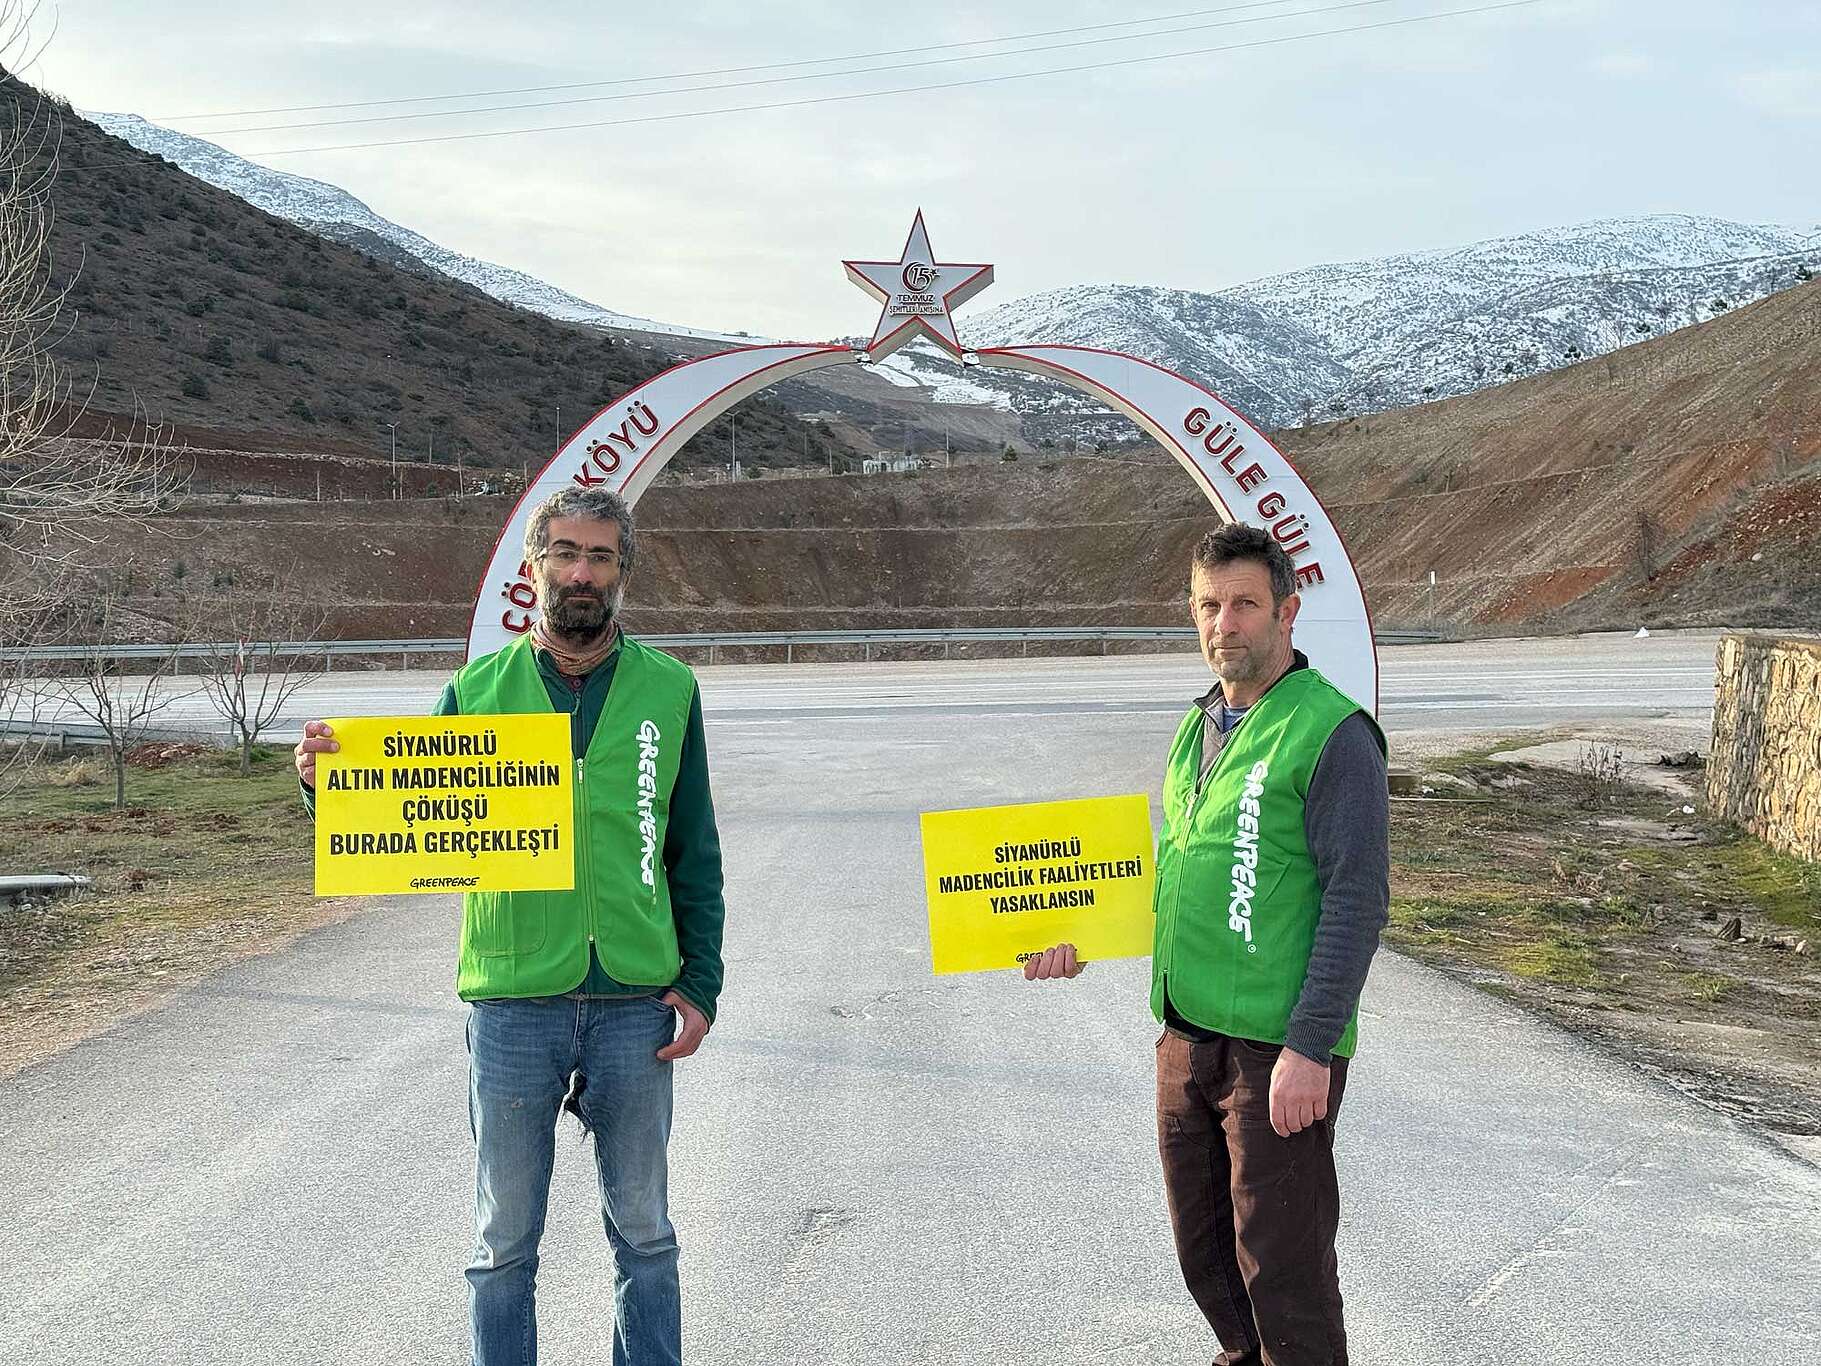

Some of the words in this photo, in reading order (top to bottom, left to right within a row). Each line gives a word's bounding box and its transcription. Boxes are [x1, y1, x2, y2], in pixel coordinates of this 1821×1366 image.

[912, 267, 931, 287] 15
[897, 294, 934, 302] TEMMUZ
[573, 400, 660, 488] KÖYÜ
[1183, 407, 1268, 494] GÜLE
[383, 729, 497, 757] SİYANÜRLÜ
[327, 768, 385, 791] ALTIN
[392, 760, 560, 790] MADENCİLİĞİNİN
[402, 794, 488, 828] ÇÖKÜŞÜ
[330, 832, 418, 856] BURADA
[424, 823, 559, 859] GERÇEKLEŞTİ
[994, 836, 1082, 864] SİYANÜRLÜ
[1228, 760, 1269, 942] GREENPEACE
[410, 876, 480, 889] GREENPEACE
[939, 865, 1035, 894] MADENCİLİK
[1039, 855, 1142, 885] FAALİYETLERİ
[990, 888, 1095, 914] YASAKLANSIN
